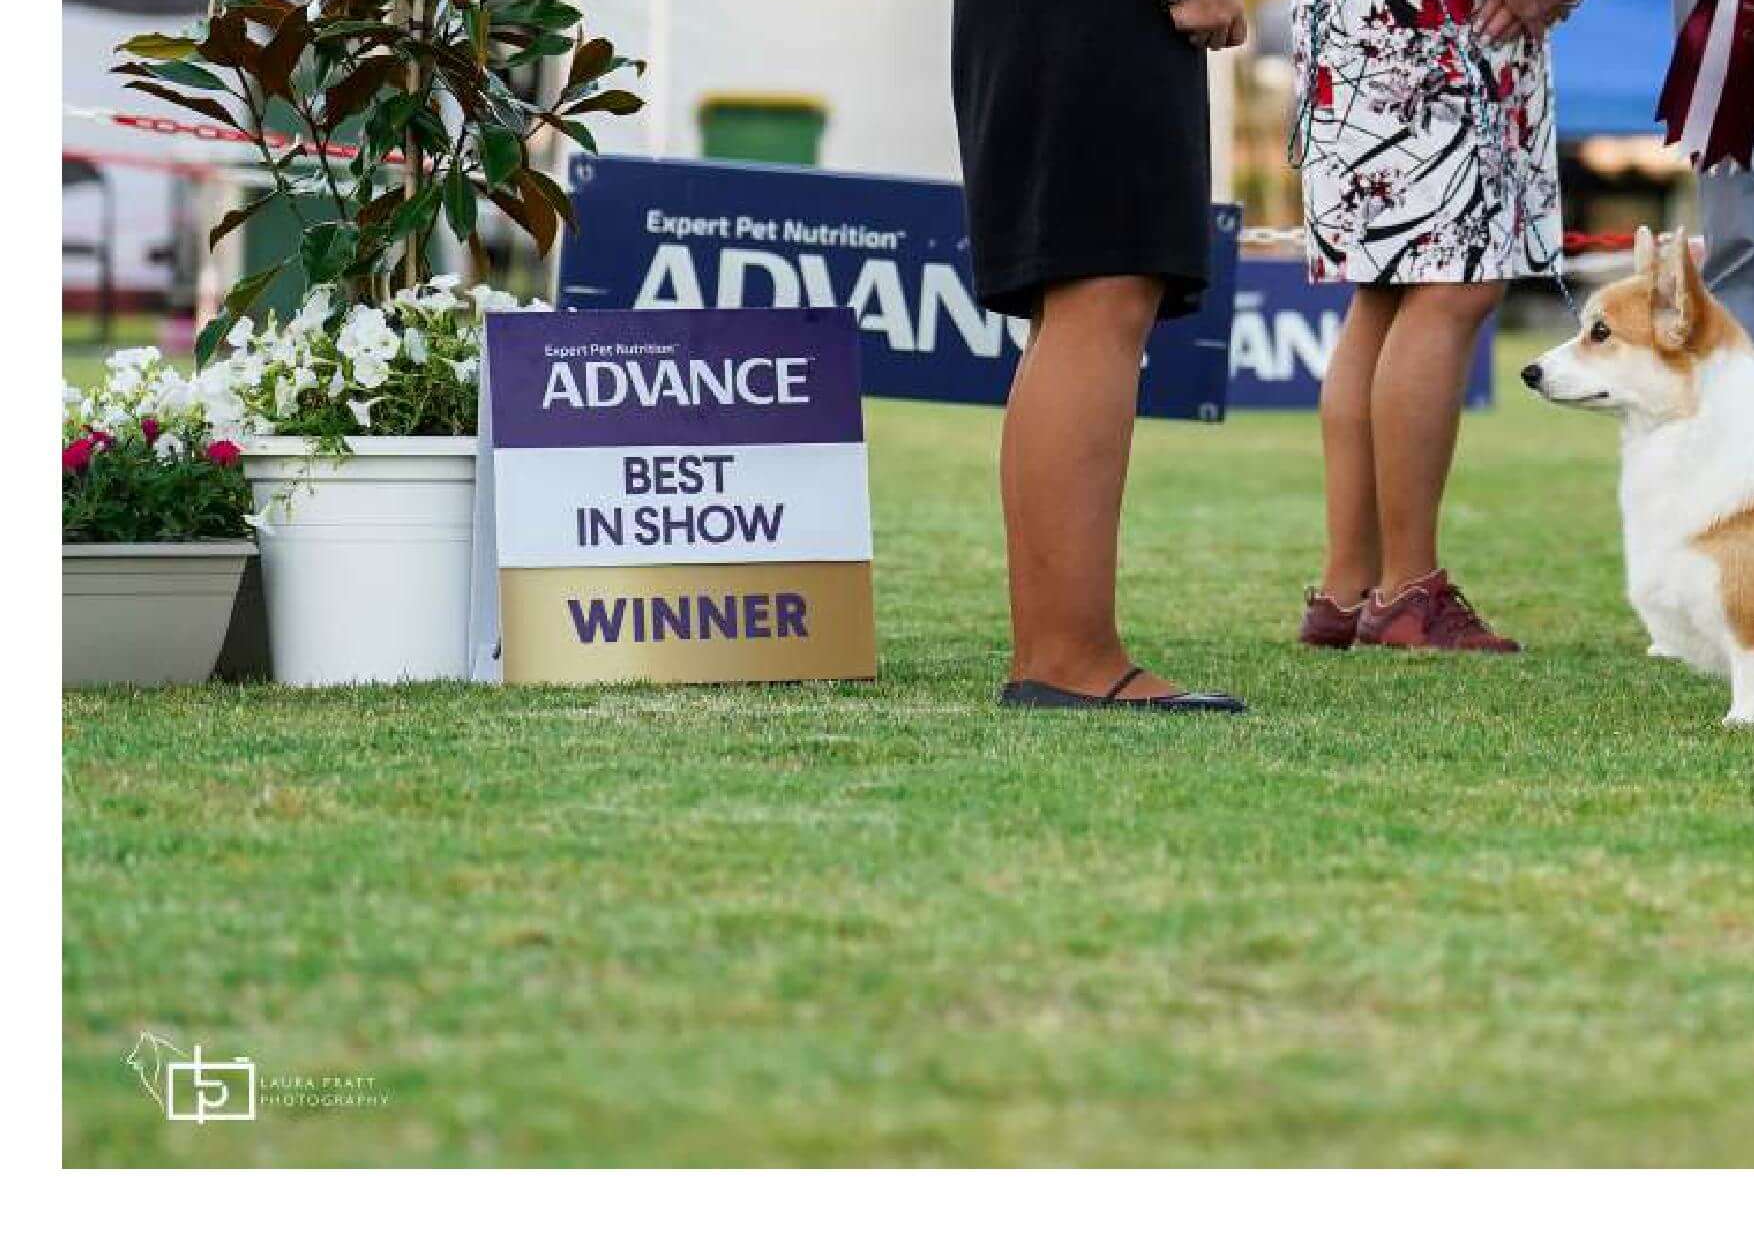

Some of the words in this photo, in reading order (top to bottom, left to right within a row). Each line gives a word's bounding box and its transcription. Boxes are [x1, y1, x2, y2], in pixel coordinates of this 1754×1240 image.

[645, 210, 730, 239] Expert
[736, 216, 778, 240] Pet
[783, 218, 898, 249] Nutrition
[544, 343, 588, 358] Expert
[590, 343, 613, 358] Pet
[541, 357, 811, 410] ADVANCE
[622, 454, 735, 495] BEST
[576, 507, 624, 546] IN
[634, 502, 784, 546] SHOW
[567, 593, 809, 644] WINNER
